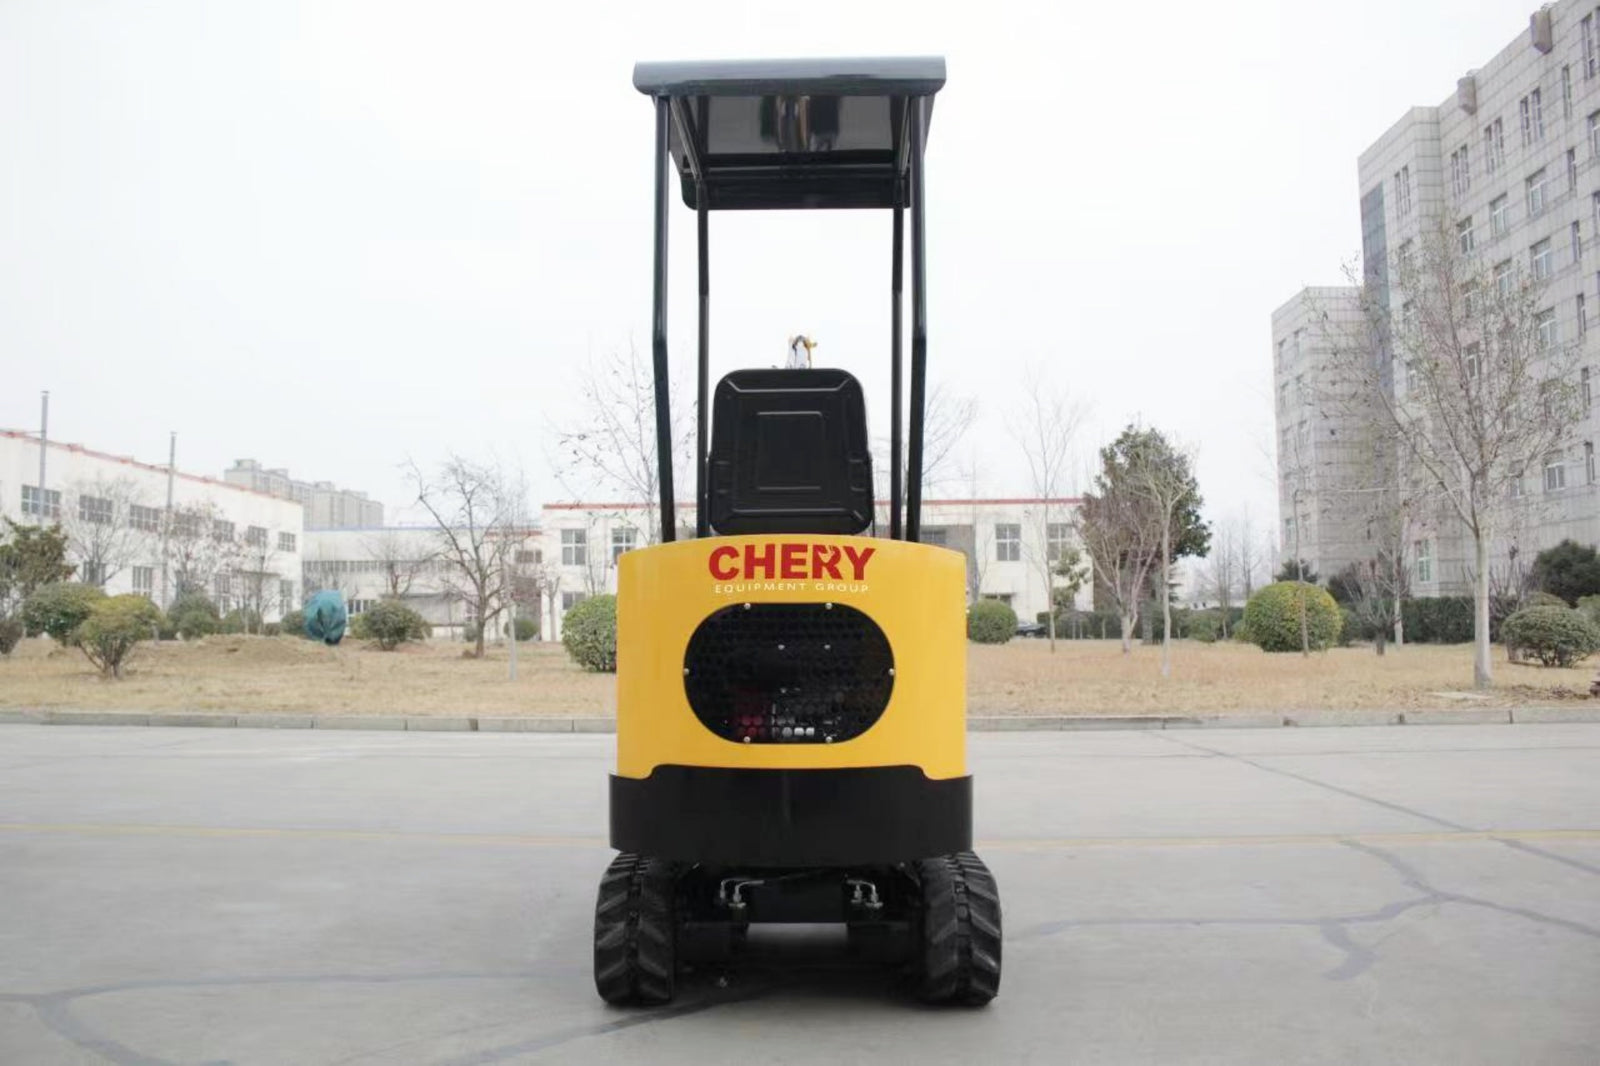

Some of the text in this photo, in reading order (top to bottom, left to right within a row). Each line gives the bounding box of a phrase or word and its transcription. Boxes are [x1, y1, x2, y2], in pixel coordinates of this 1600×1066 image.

[709, 544, 876, 581] CHERY
[714, 583, 870, 594] EQUIPMENT GROUP
